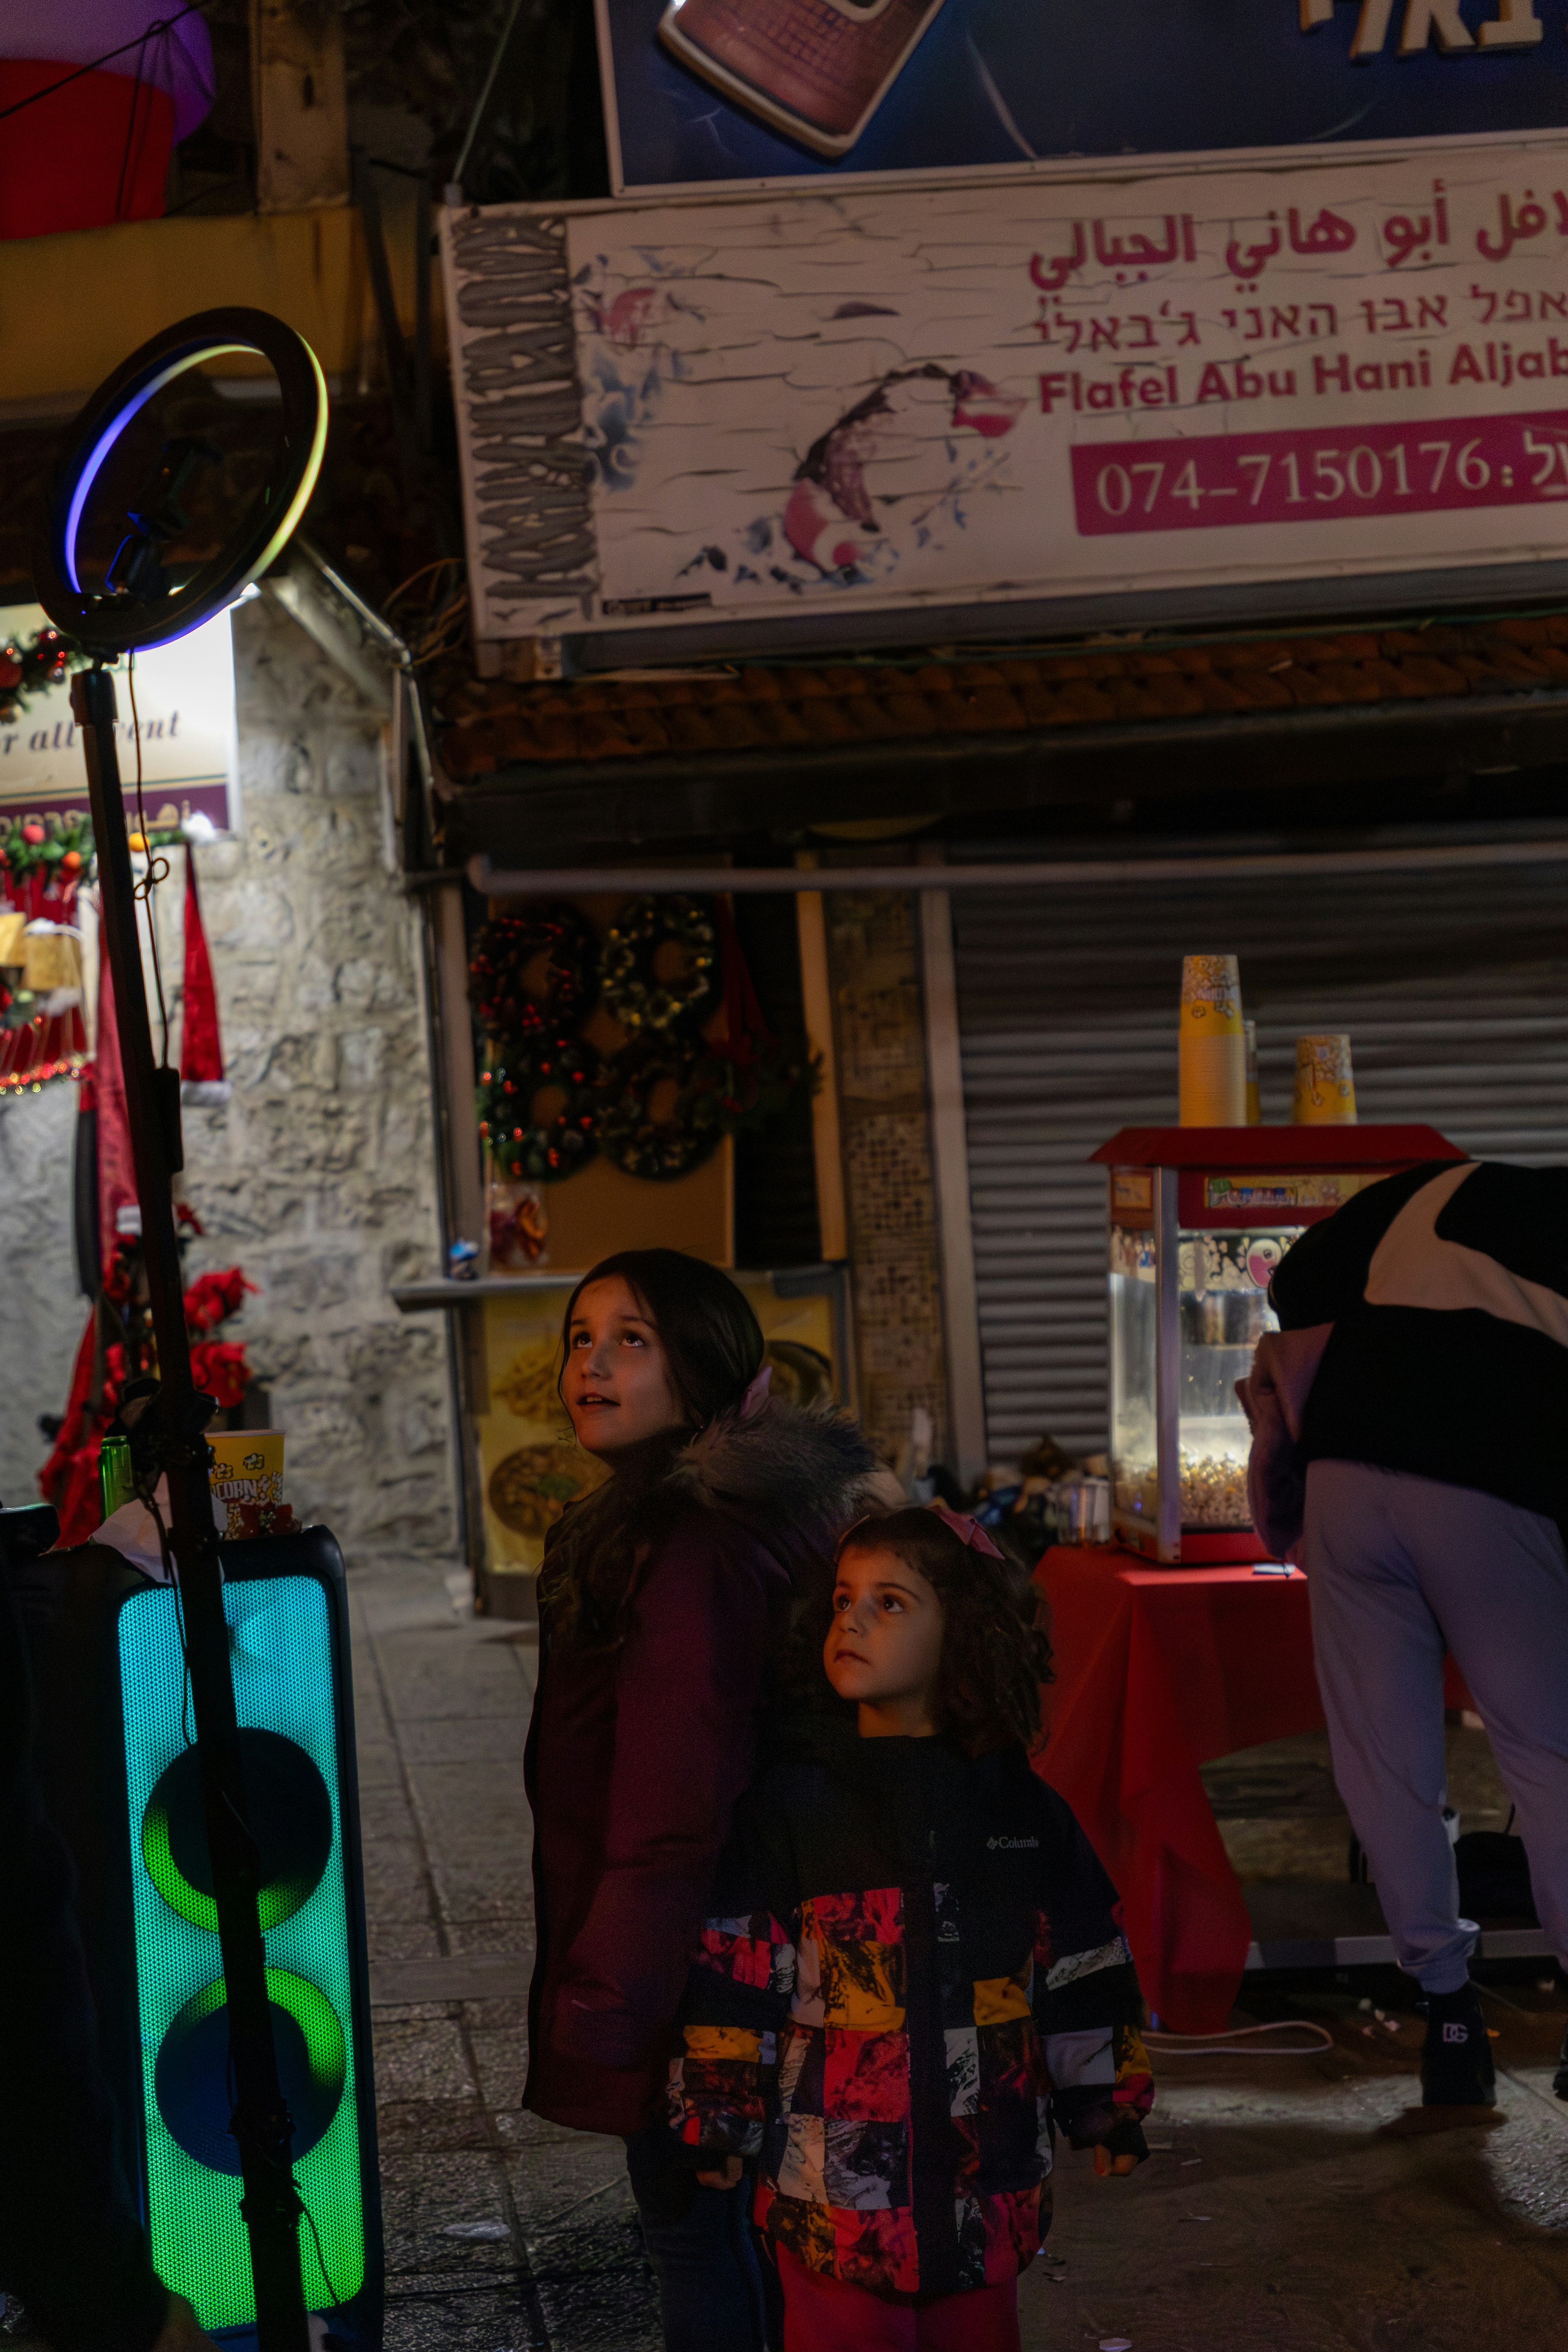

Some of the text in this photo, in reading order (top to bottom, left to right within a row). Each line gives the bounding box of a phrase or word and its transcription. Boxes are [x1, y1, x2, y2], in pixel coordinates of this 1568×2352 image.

[1224, 207, 1357, 293] هاني
[1382, 178, 1448, 268] أبو
[1028, 214, 1197, 306] الجبالي
[1220, 303, 1336, 340] האני
[1361, 294, 1447, 334] אבו
[1038, 365, 1178, 415] Flafel
[1195, 361, 1297, 403] Abu
[1313, 349, 1432, 395] Hani
[29, 720, 76, 751] all
